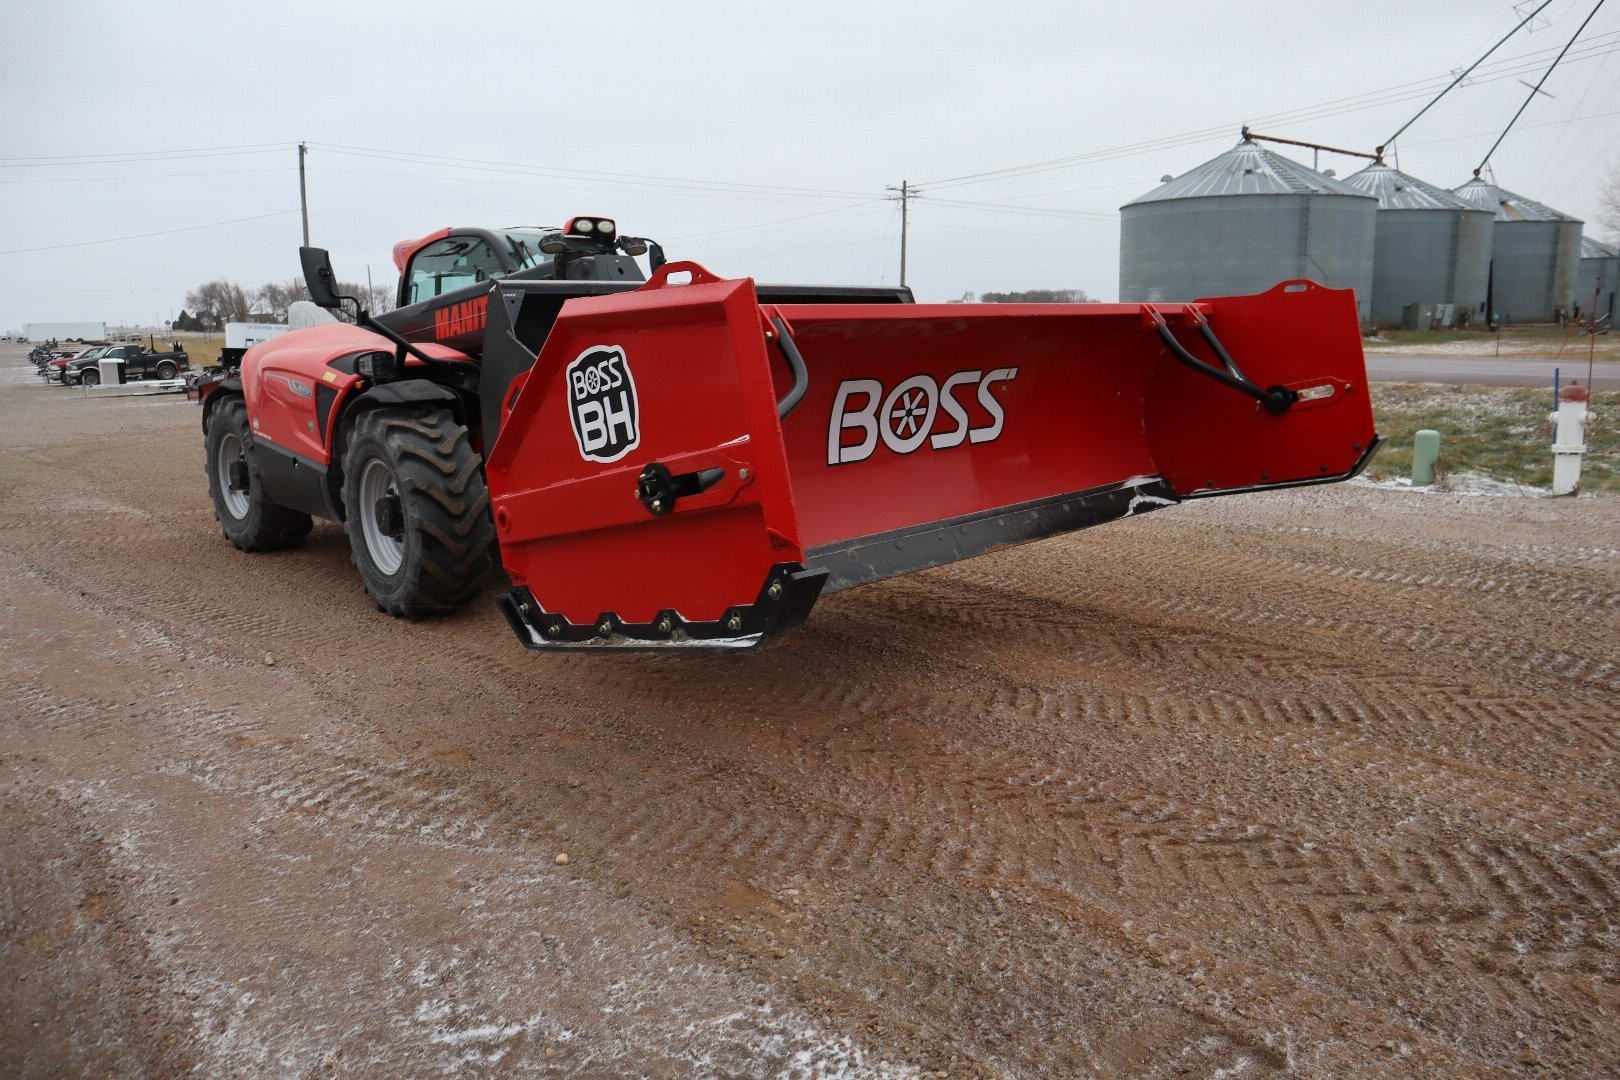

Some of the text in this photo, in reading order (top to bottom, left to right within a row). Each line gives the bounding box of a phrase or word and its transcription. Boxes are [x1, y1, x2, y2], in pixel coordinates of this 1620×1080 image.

[435, 295, 489, 340] MANIT
[572, 355, 620, 401] BOSS
[577, 390, 635, 452] BH
[827, 367, 1019, 466] BOSS
